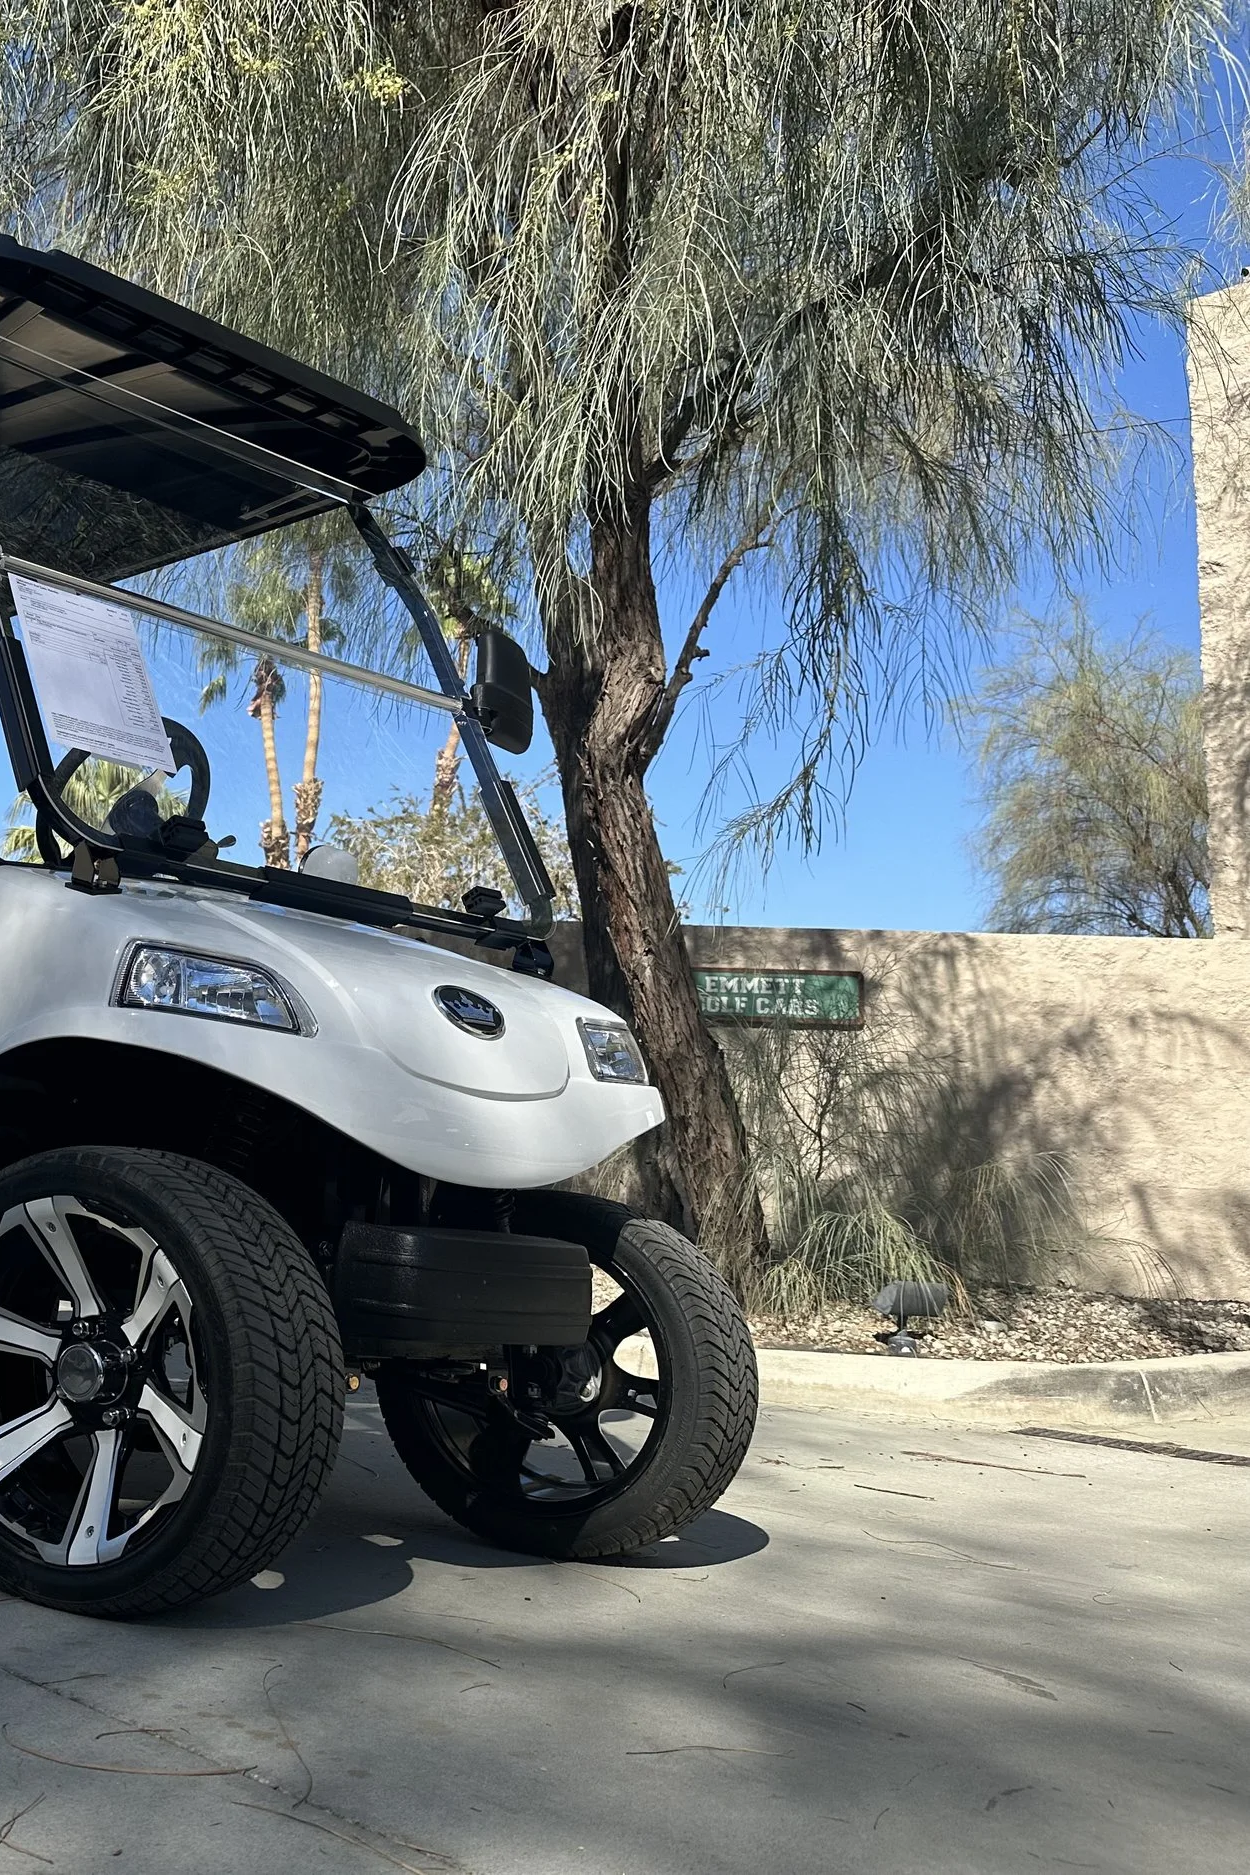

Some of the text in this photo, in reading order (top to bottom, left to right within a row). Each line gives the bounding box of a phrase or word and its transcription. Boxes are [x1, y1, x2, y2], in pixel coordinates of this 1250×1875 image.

[705, 976, 805, 995] EMMETT
[701, 996, 820, 1016] OLF CARS
